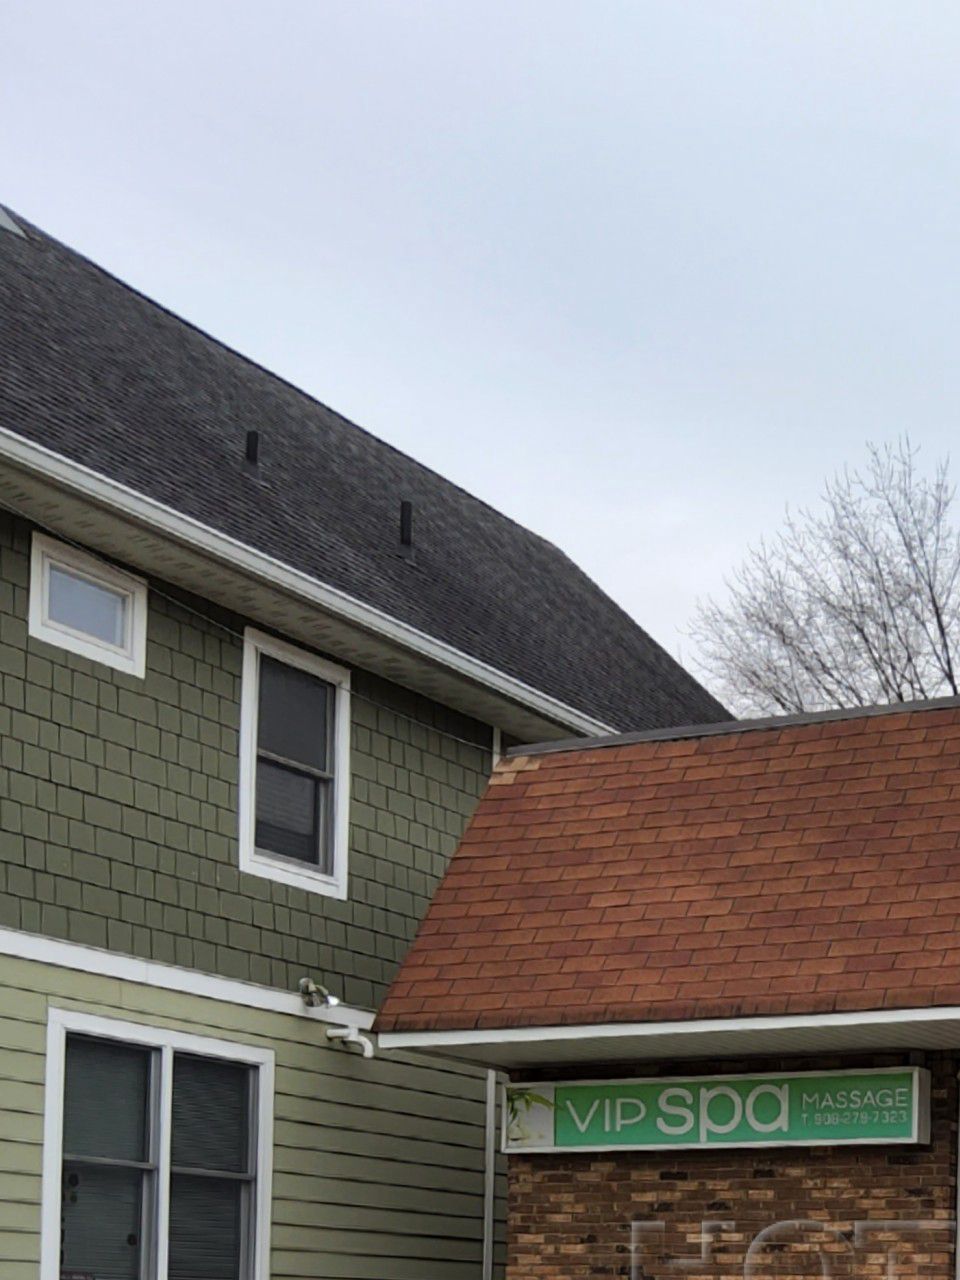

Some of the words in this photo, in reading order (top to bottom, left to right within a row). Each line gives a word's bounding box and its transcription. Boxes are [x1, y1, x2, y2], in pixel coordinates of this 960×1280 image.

[566, 1098, 645, 1134] VIP
[656, 1083, 789, 1143] spa
[801, 1088, 908, 1110] MASSAGE
